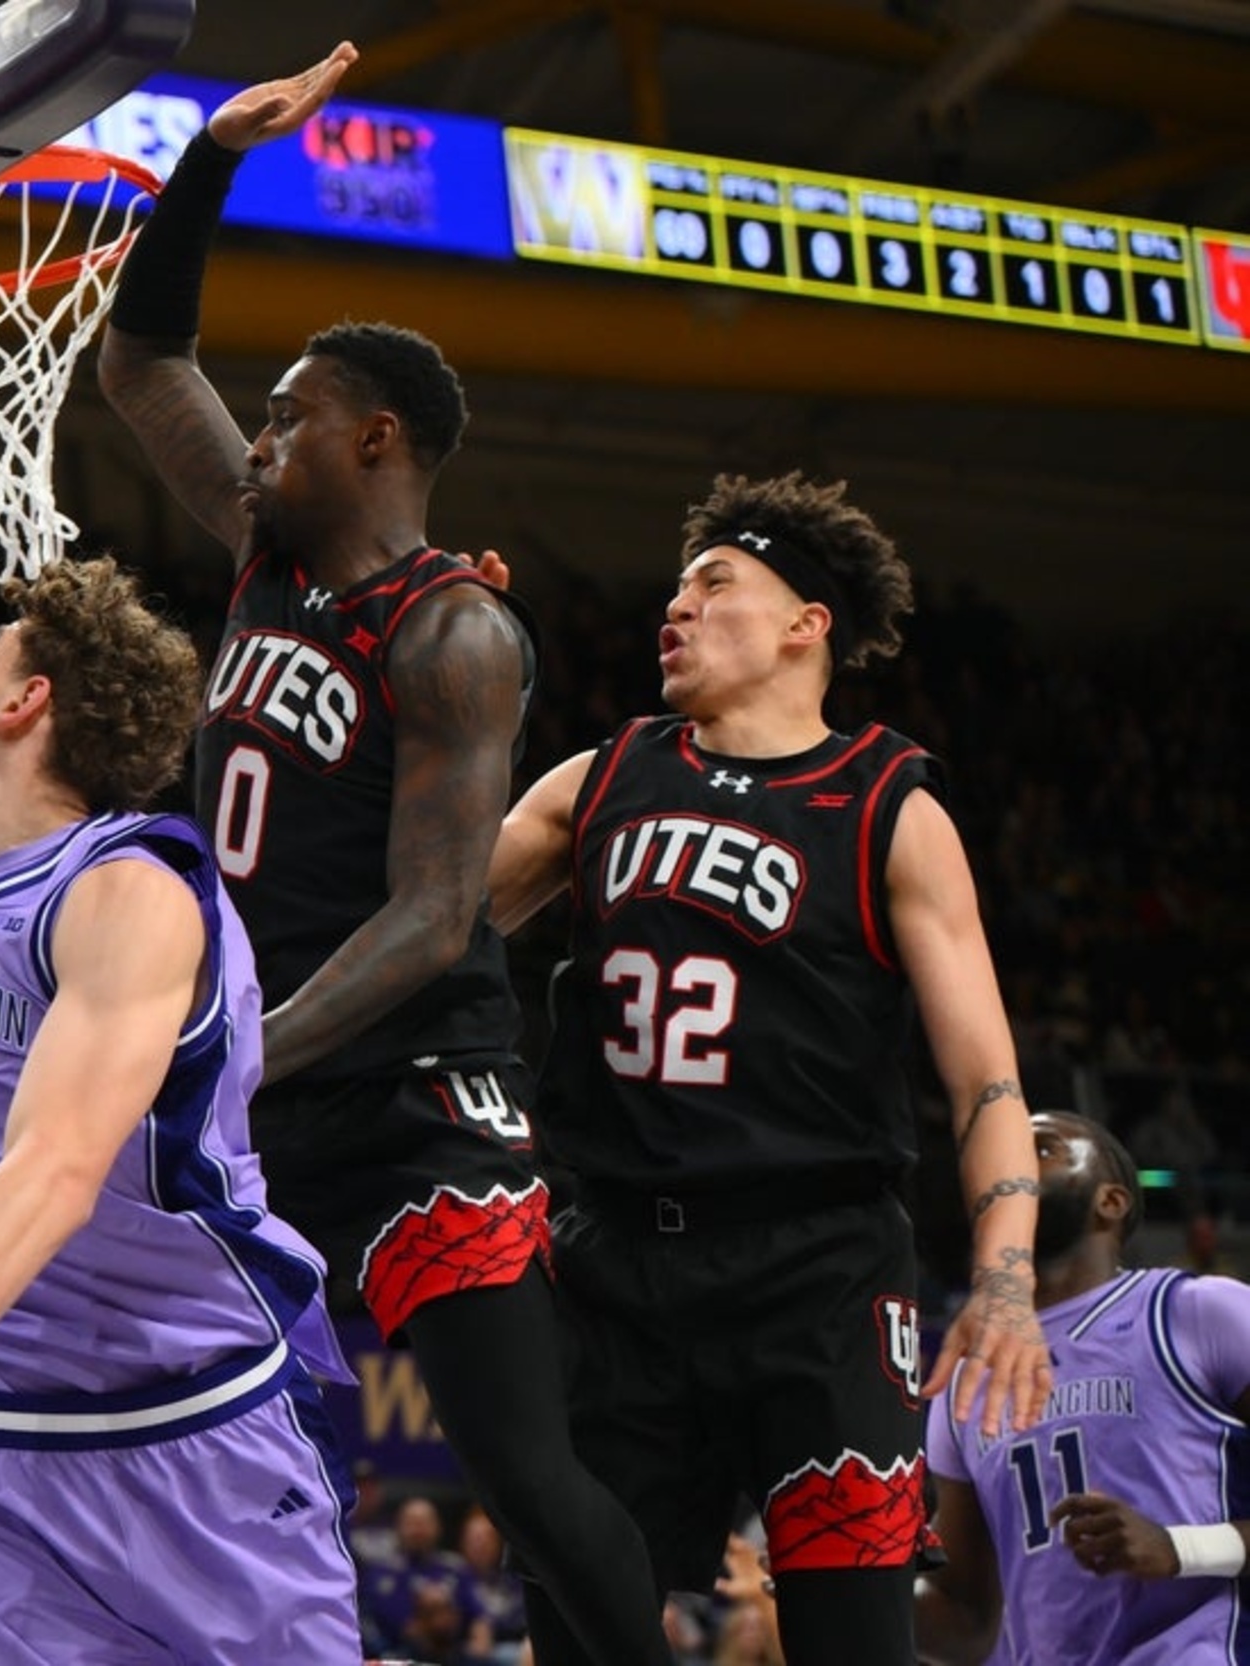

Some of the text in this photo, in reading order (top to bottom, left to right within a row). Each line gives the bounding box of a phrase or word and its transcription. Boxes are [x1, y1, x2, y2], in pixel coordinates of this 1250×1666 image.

[879, 240, 910, 288] 3
[948, 249, 979, 297] 2
[1021, 259, 1046, 306] 1
[1083, 268, 1111, 315] 0
[1151, 277, 1175, 323] 1
[207, 635, 359, 763] UTES
[215, 744, 270, 880] 0
[604, 817, 800, 931] UTES
[602, 948, 737, 1085] 32
[1007, 1425, 1092, 1555] 11
